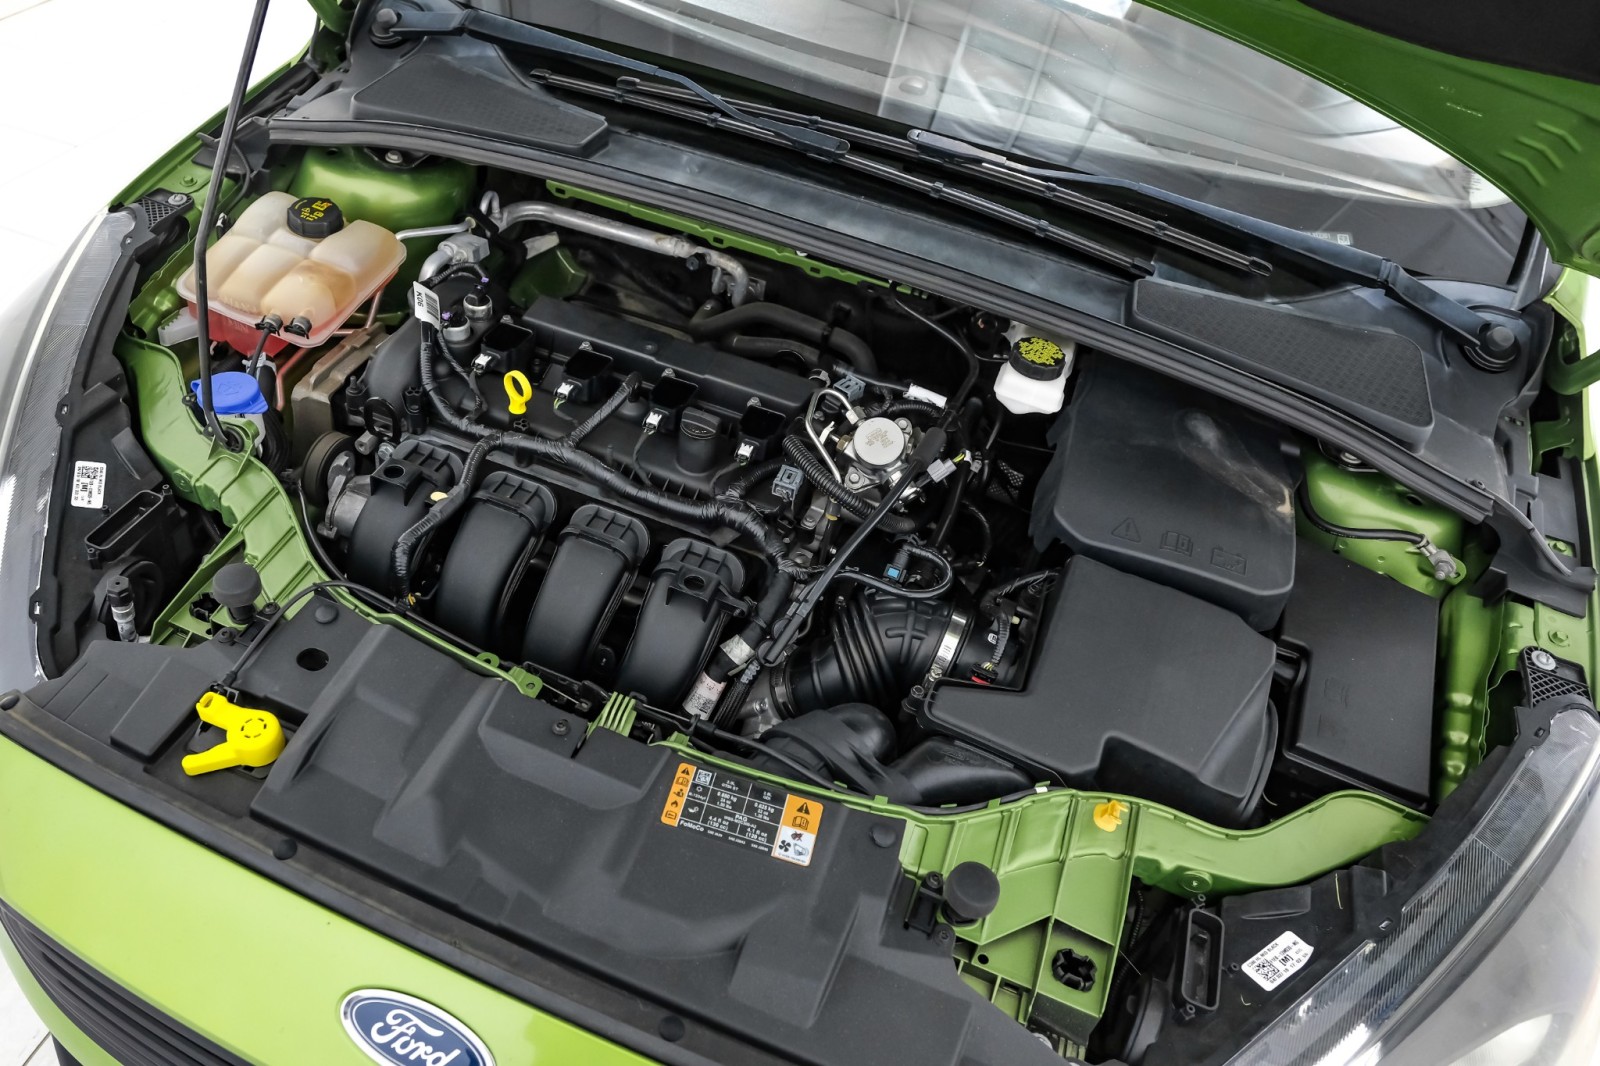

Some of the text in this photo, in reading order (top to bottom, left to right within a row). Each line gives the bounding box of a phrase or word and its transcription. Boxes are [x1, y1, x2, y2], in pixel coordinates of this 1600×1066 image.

[416, 291, 424, 307] K06
[735, 814, 748, 822] PAG
[679, 820, 705, 832] FoMoCo
[1266, 942, 1279, 952] BLACK
[371, 1009, 460, 1066] Ford
